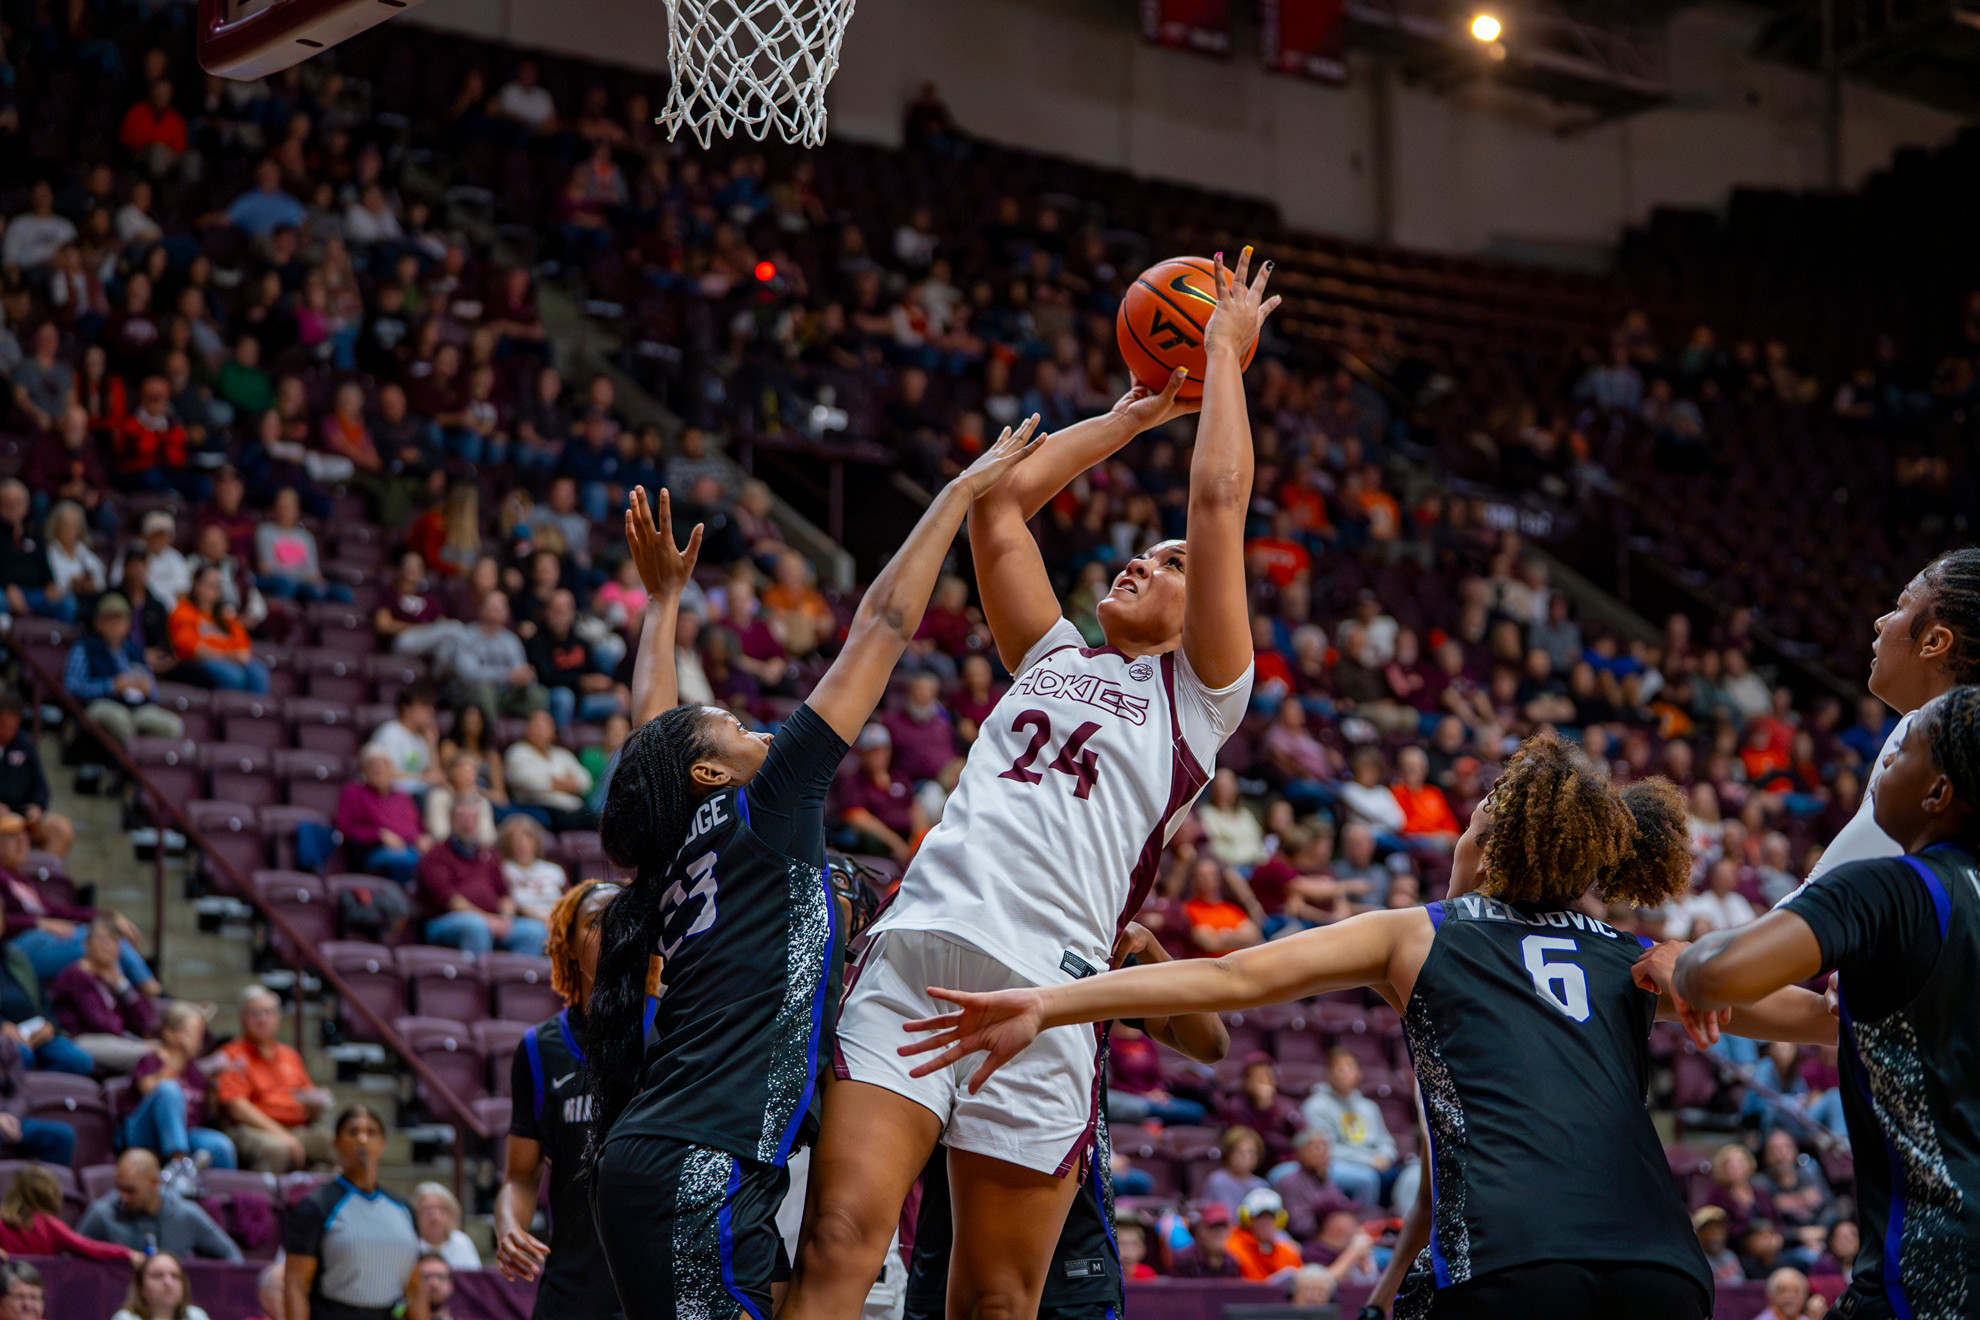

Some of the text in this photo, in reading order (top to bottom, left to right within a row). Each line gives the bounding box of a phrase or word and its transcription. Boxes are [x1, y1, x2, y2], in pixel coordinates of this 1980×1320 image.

[1150, 308, 1199, 350] VT
[1009, 667, 1150, 726] HOKIES
[997, 709, 1103, 800] 24
[658, 850, 719, 962] 23
[1462, 896, 1618, 939] VELJOVIC
[1519, 933, 1592, 1024] 6
[1092, 1263, 1101, 1271] M
